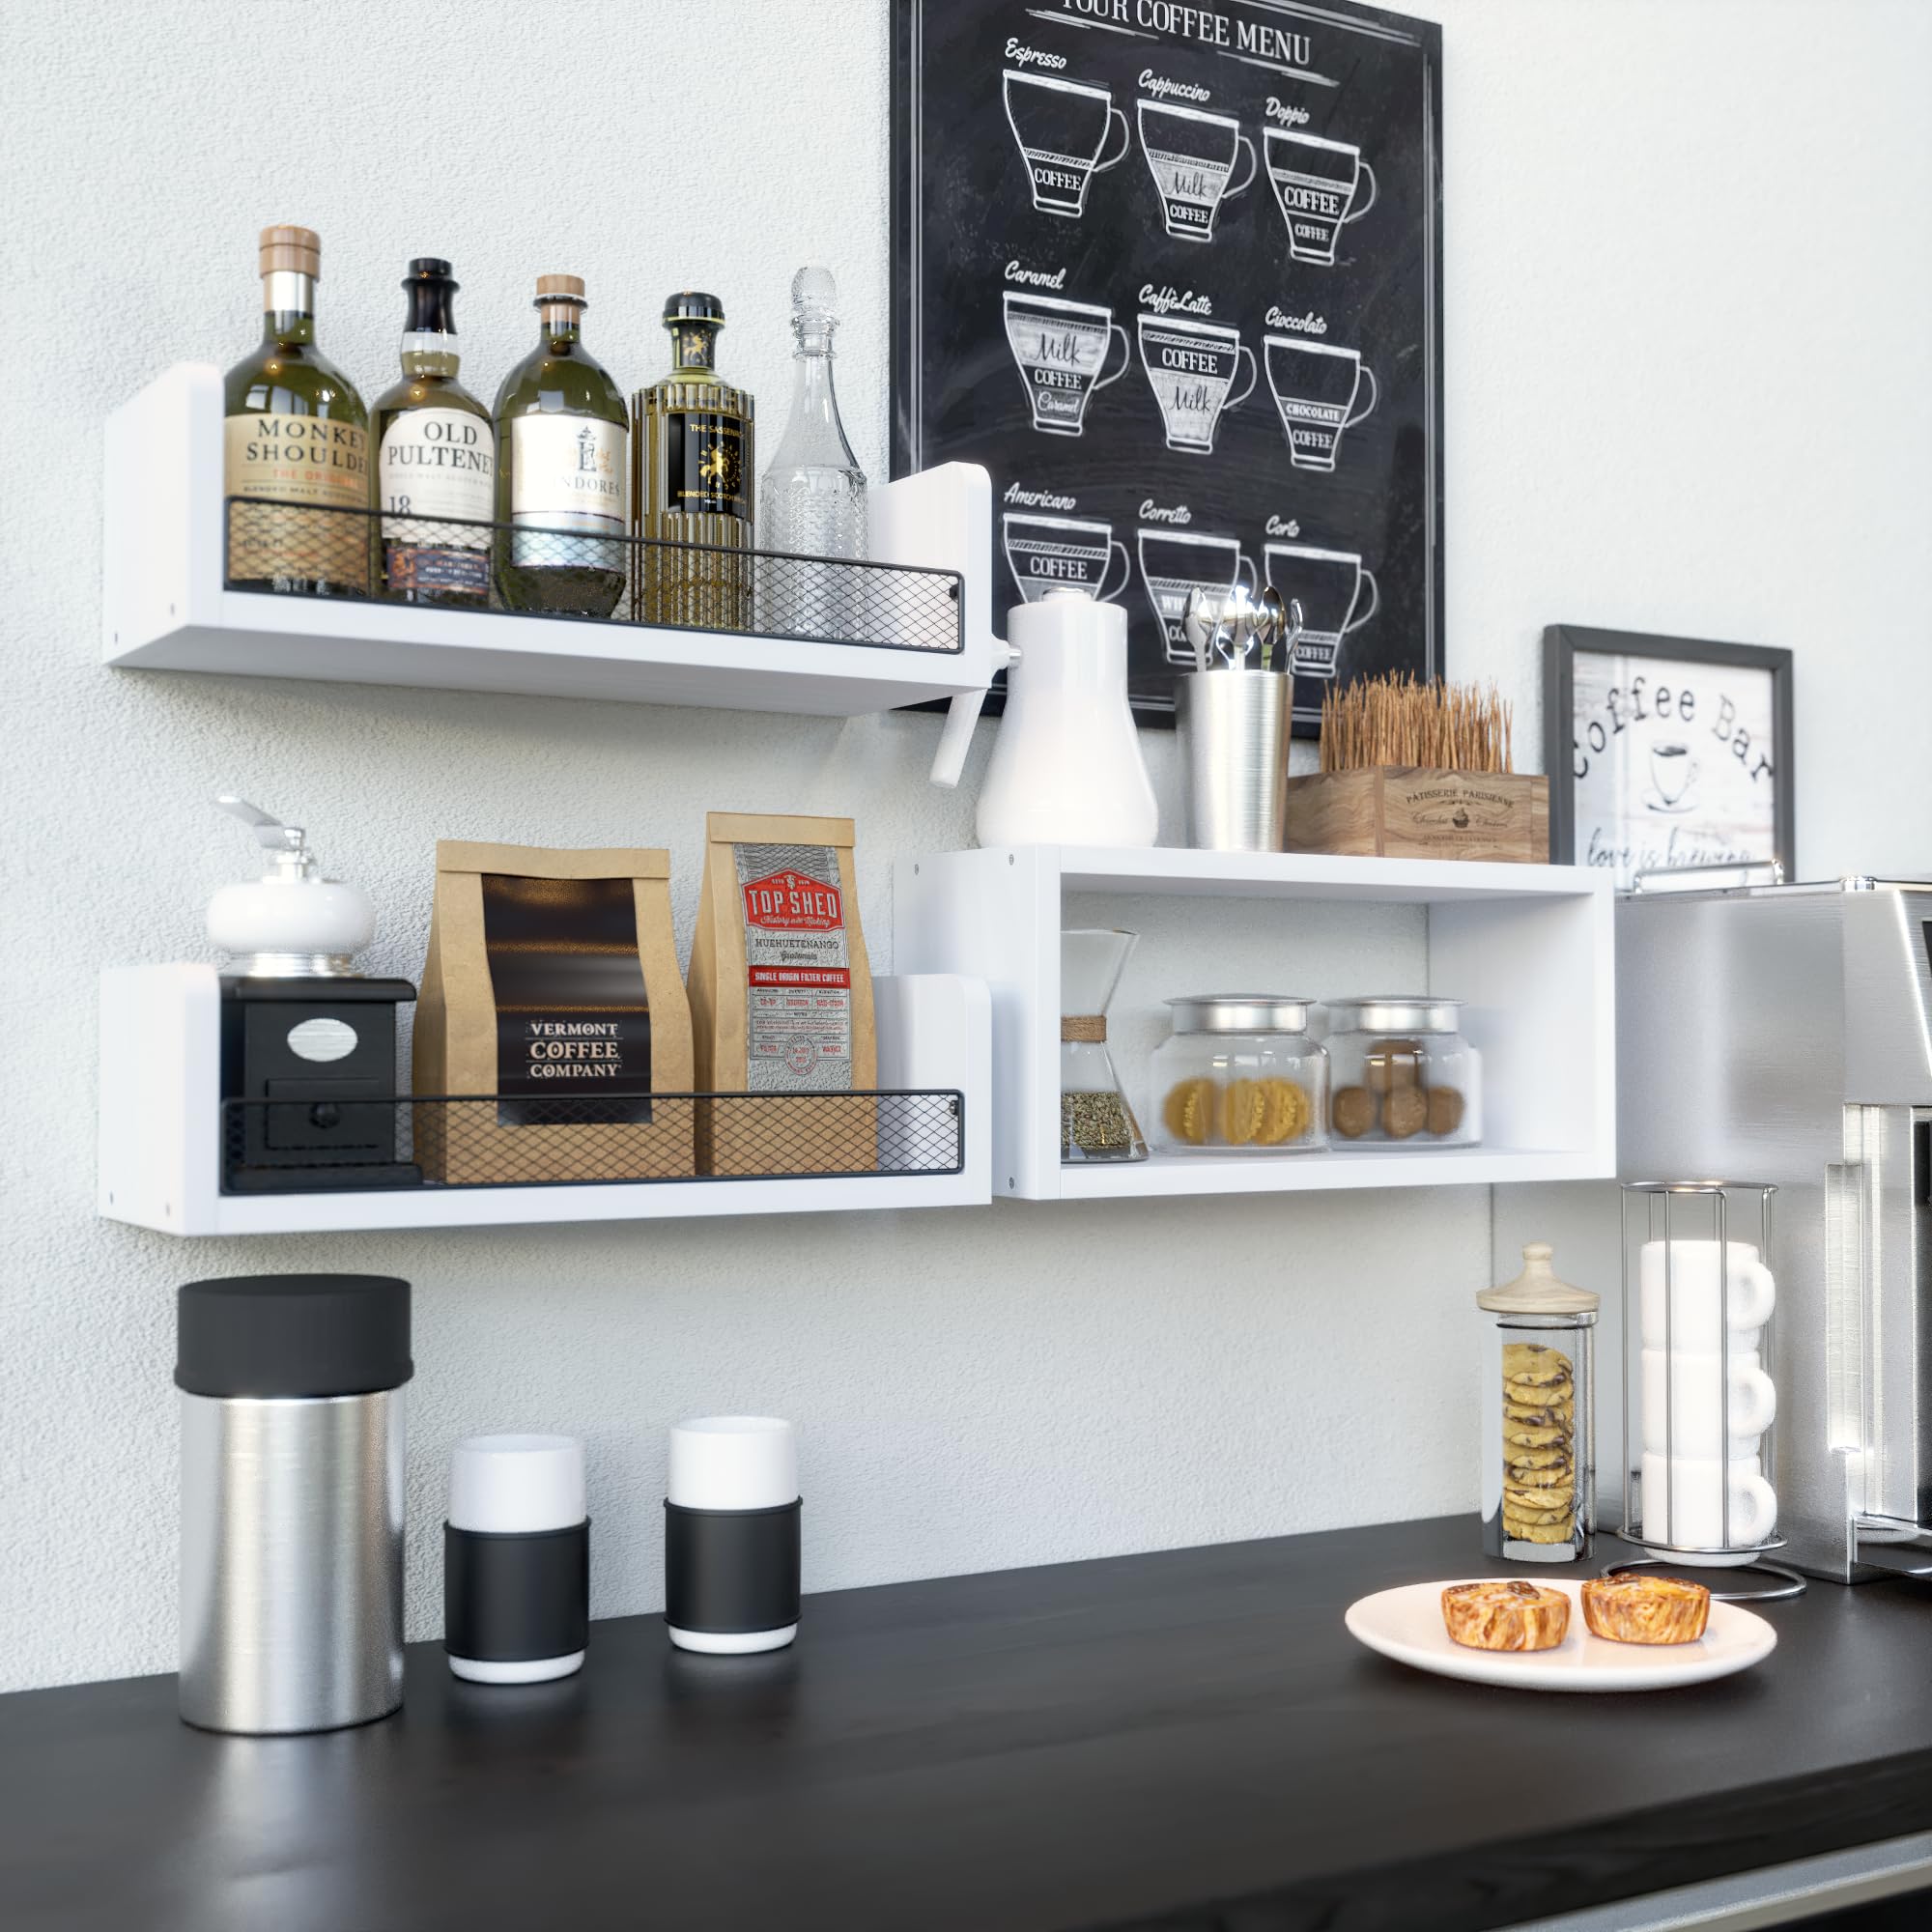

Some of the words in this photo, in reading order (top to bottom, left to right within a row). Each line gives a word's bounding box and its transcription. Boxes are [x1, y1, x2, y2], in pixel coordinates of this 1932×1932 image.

[1137, 0, 1230, 46] COFFEE
[1236, 19, 1312, 65] MENU
[1005, 37, 1066, 70] Espresso
[1138, 69, 1210, 102] Cappuccino
[1265, 97, 1310, 126] Doppio
[1034, 167, 1082, 191] COFFEE
[1165, 171, 1207, 200] Milk
[1169, 203, 1208, 224] COFFEE
[1284, 185, 1340, 215] COFFEE
[1294, 223, 1329, 242] COFFEE
[1005, 260, 1065, 290] Caramel
[1265, 305, 1327, 334] Cioccolato
[1031, 332, 1081, 367] Milk
[1161, 348, 1218, 375] COFFEE
[1034, 368, 1082, 390] COFFEE
[1168, 384, 1210, 415] Milk
[1286, 402, 1341, 422] CHOCOLATE
[424, 421, 477, 445] OLD
[690, 423, 707, 433] THE
[1293, 429, 1333, 449] COFFEE
[246, 442, 367, 473] SHOULDE
[389, 495, 412, 517] 18
[1005, 482, 1076, 511] Americano
[1139, 499, 1192, 526] Corretto
[1266, 516, 1300, 538] Corto
[1030, 555, 1088, 581] COFFEE
[1295, 645, 1333, 662] COFFEE
[1711, 694, 1774, 781] Bar
[1588, 827, 1630, 868] love
[749, 890, 783, 916] TOP
[789, 891, 838, 919] SHED
[754, 972, 777, 980] SINGLE
[801, 973, 821, 982] FILTER
[822, 974, 844, 983] COFFEE
[531, 1023, 618, 1037] VERMONT
[530, 1041, 619, 1060] COFFEE
[530, 1064, 618, 1077] COMPANY
